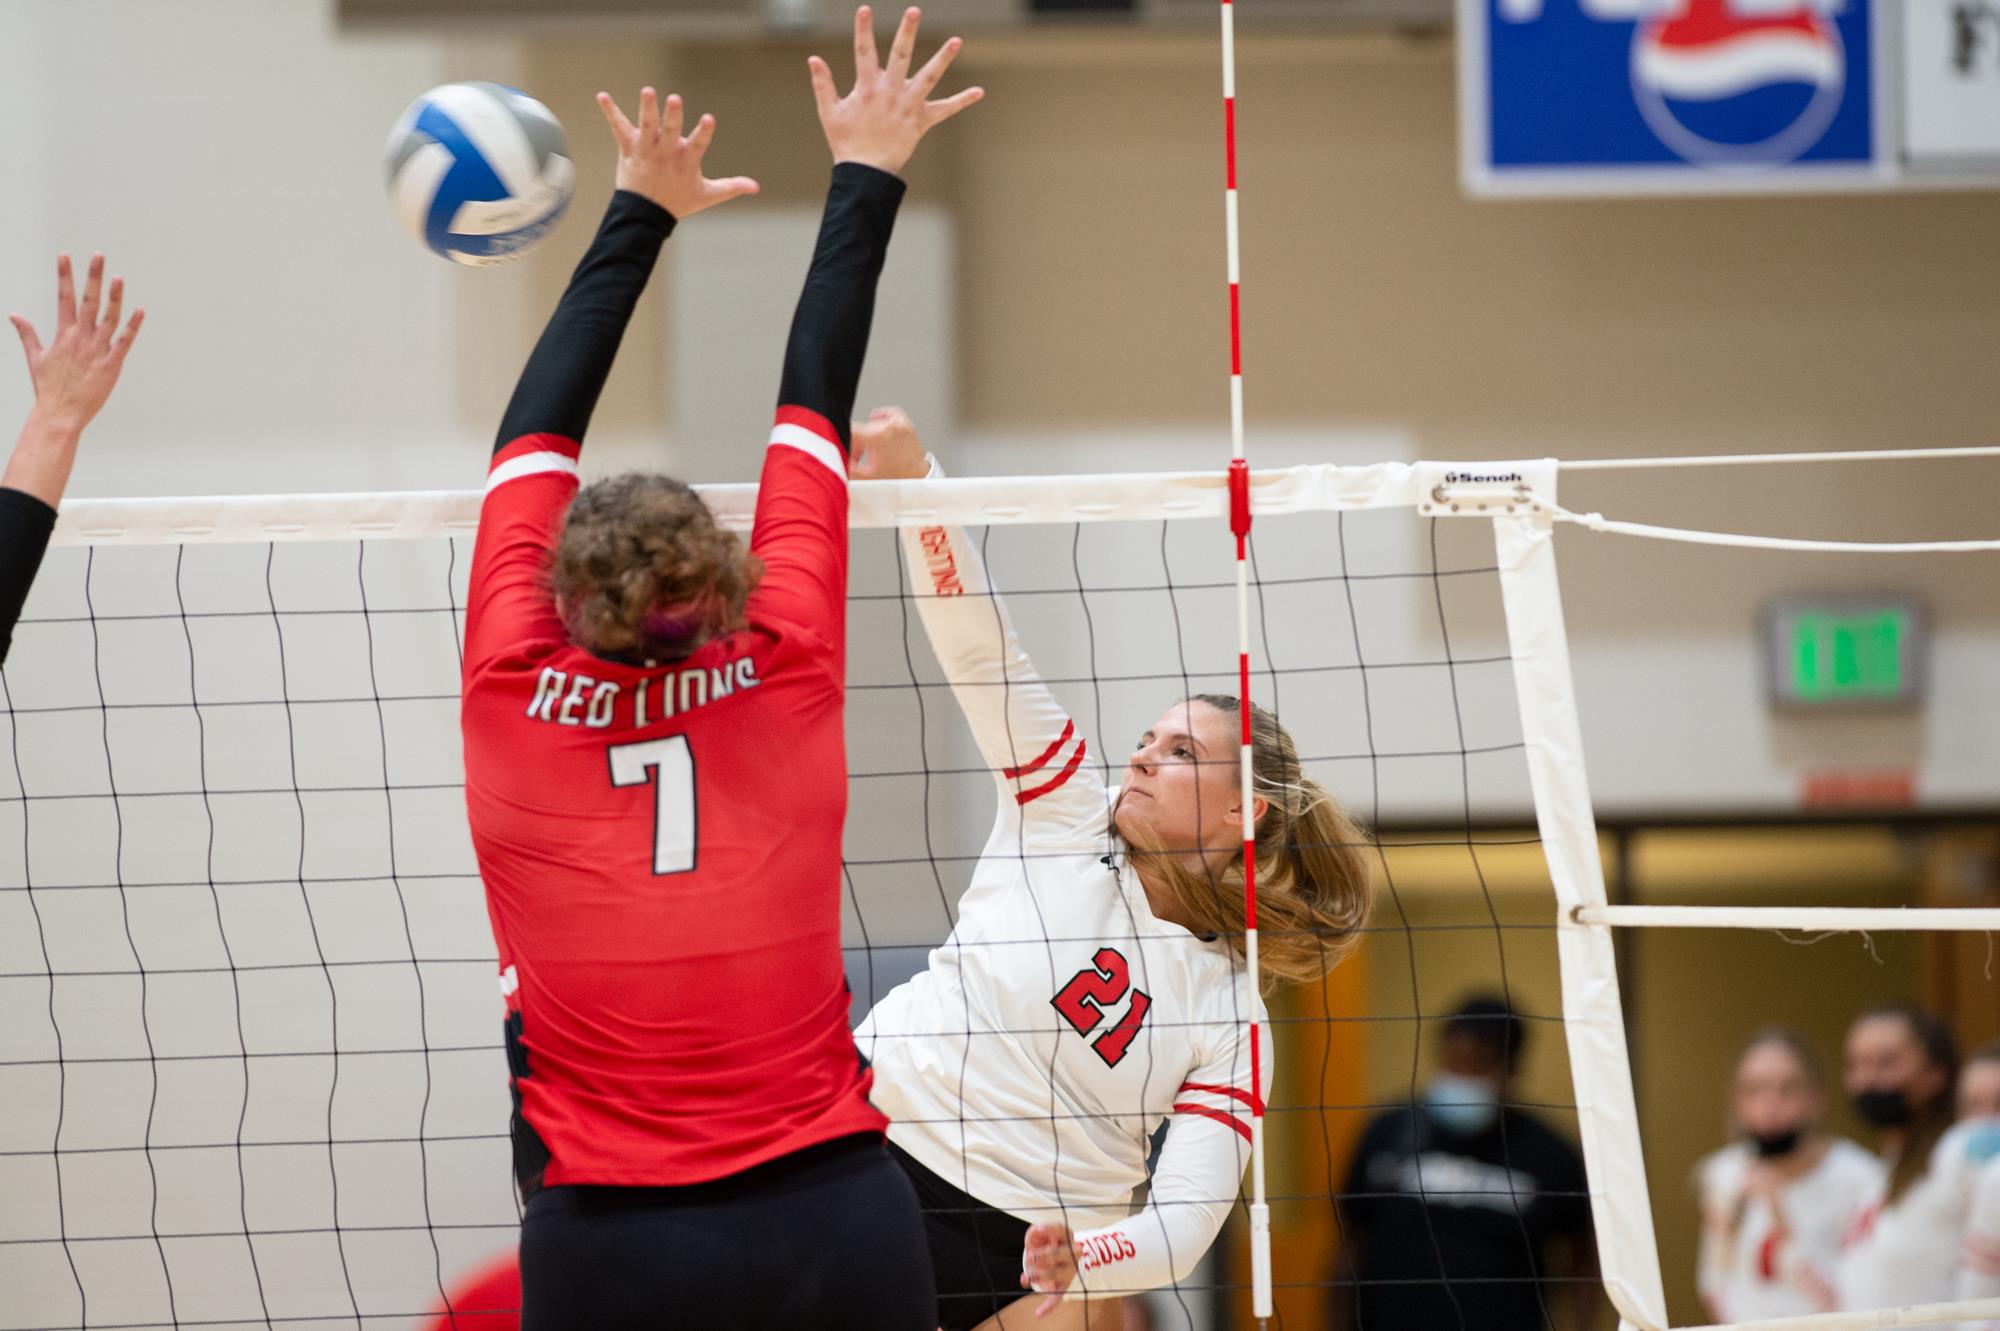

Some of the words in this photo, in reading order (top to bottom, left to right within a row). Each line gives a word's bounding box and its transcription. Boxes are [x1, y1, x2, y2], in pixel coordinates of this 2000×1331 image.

[525, 665, 621, 729] RED
[633, 655, 761, 729] LIONS
[607, 733, 698, 876] 7
[1049, 947, 1153, 1068] 21
